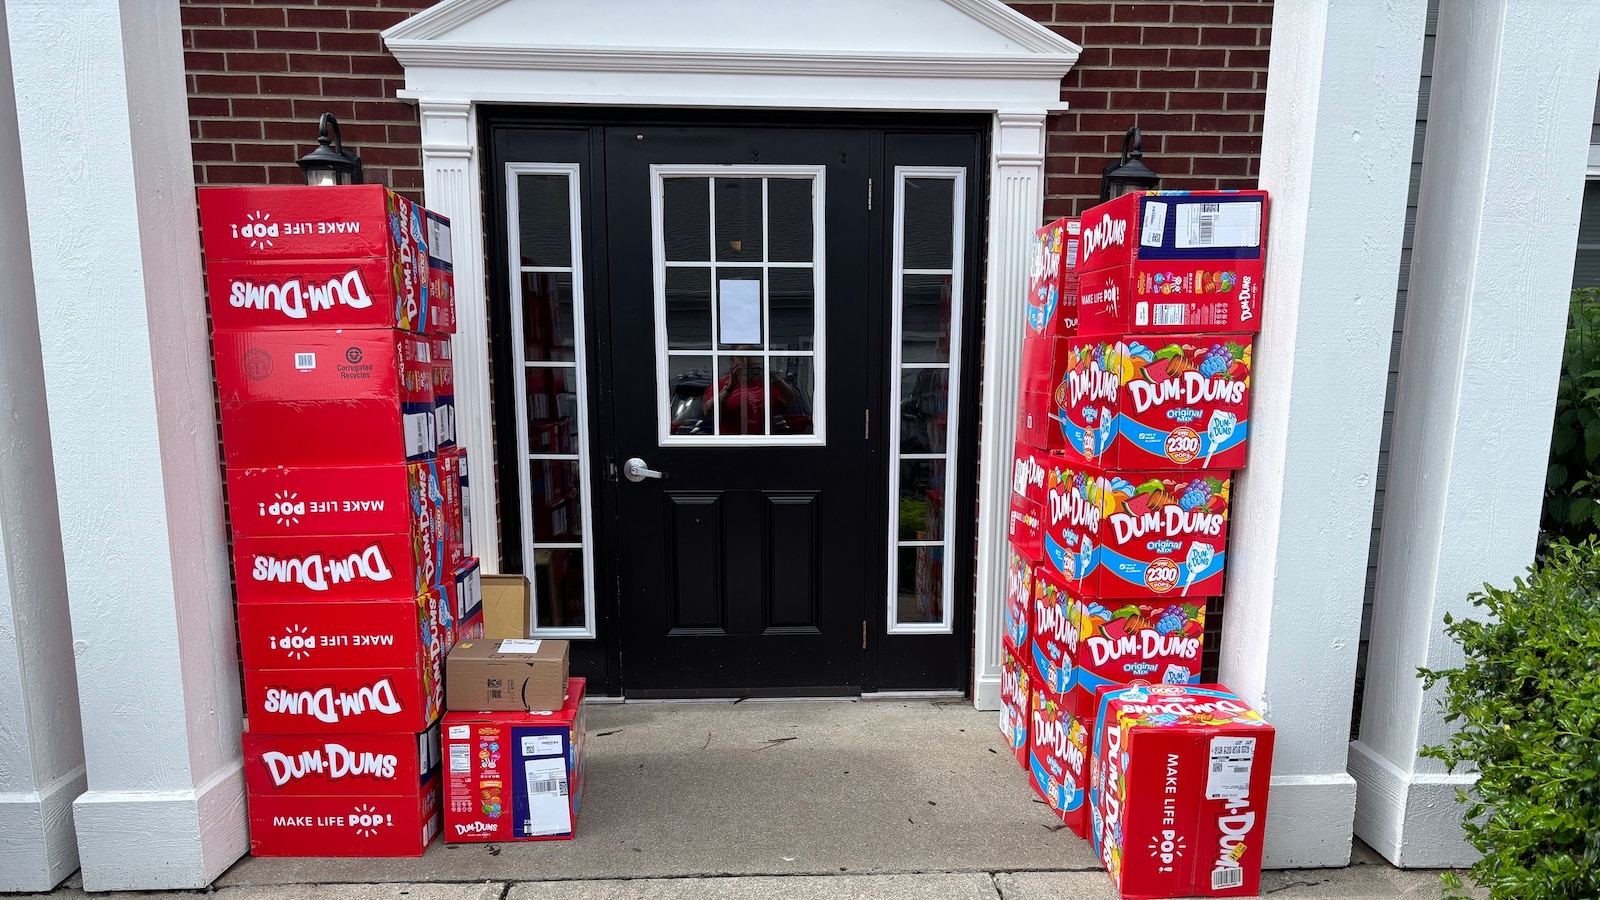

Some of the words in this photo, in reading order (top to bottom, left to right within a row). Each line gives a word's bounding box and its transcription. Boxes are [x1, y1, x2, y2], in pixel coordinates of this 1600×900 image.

[231, 223, 279, 238] POP!
[284, 223, 312, 235] LIFE
[318, 222, 360, 234] MAKE
[1093, 291, 1103, 303] LIFE
[336, 363, 373, 373] Corrugated
[340, 371, 371, 380] Recycles
[1167, 408, 1203, 419] Original
[1168, 437, 1198, 452] 2300
[258, 502, 305, 516] POP!
[310, 501, 338, 512] LIFE
[343, 500, 385, 511] MAKE
[1146, 540, 1182, 550] Original
[1147, 568, 1177, 582] 2300
[270, 636, 316, 650] POP!
[320, 636, 348, 646] LIFE
[353, 635, 393, 646] MAKE
[1123, 662, 1159, 672] Original
[1165, 753, 1179, 794] MAKE
[1163, 798, 1175, 826] LIFE
[273, 816, 313, 827] MAKE
[317, 816, 345, 826] LIFE
[349, 814, 394, 827] POP!
[1159, 830, 1176, 873] POP!
